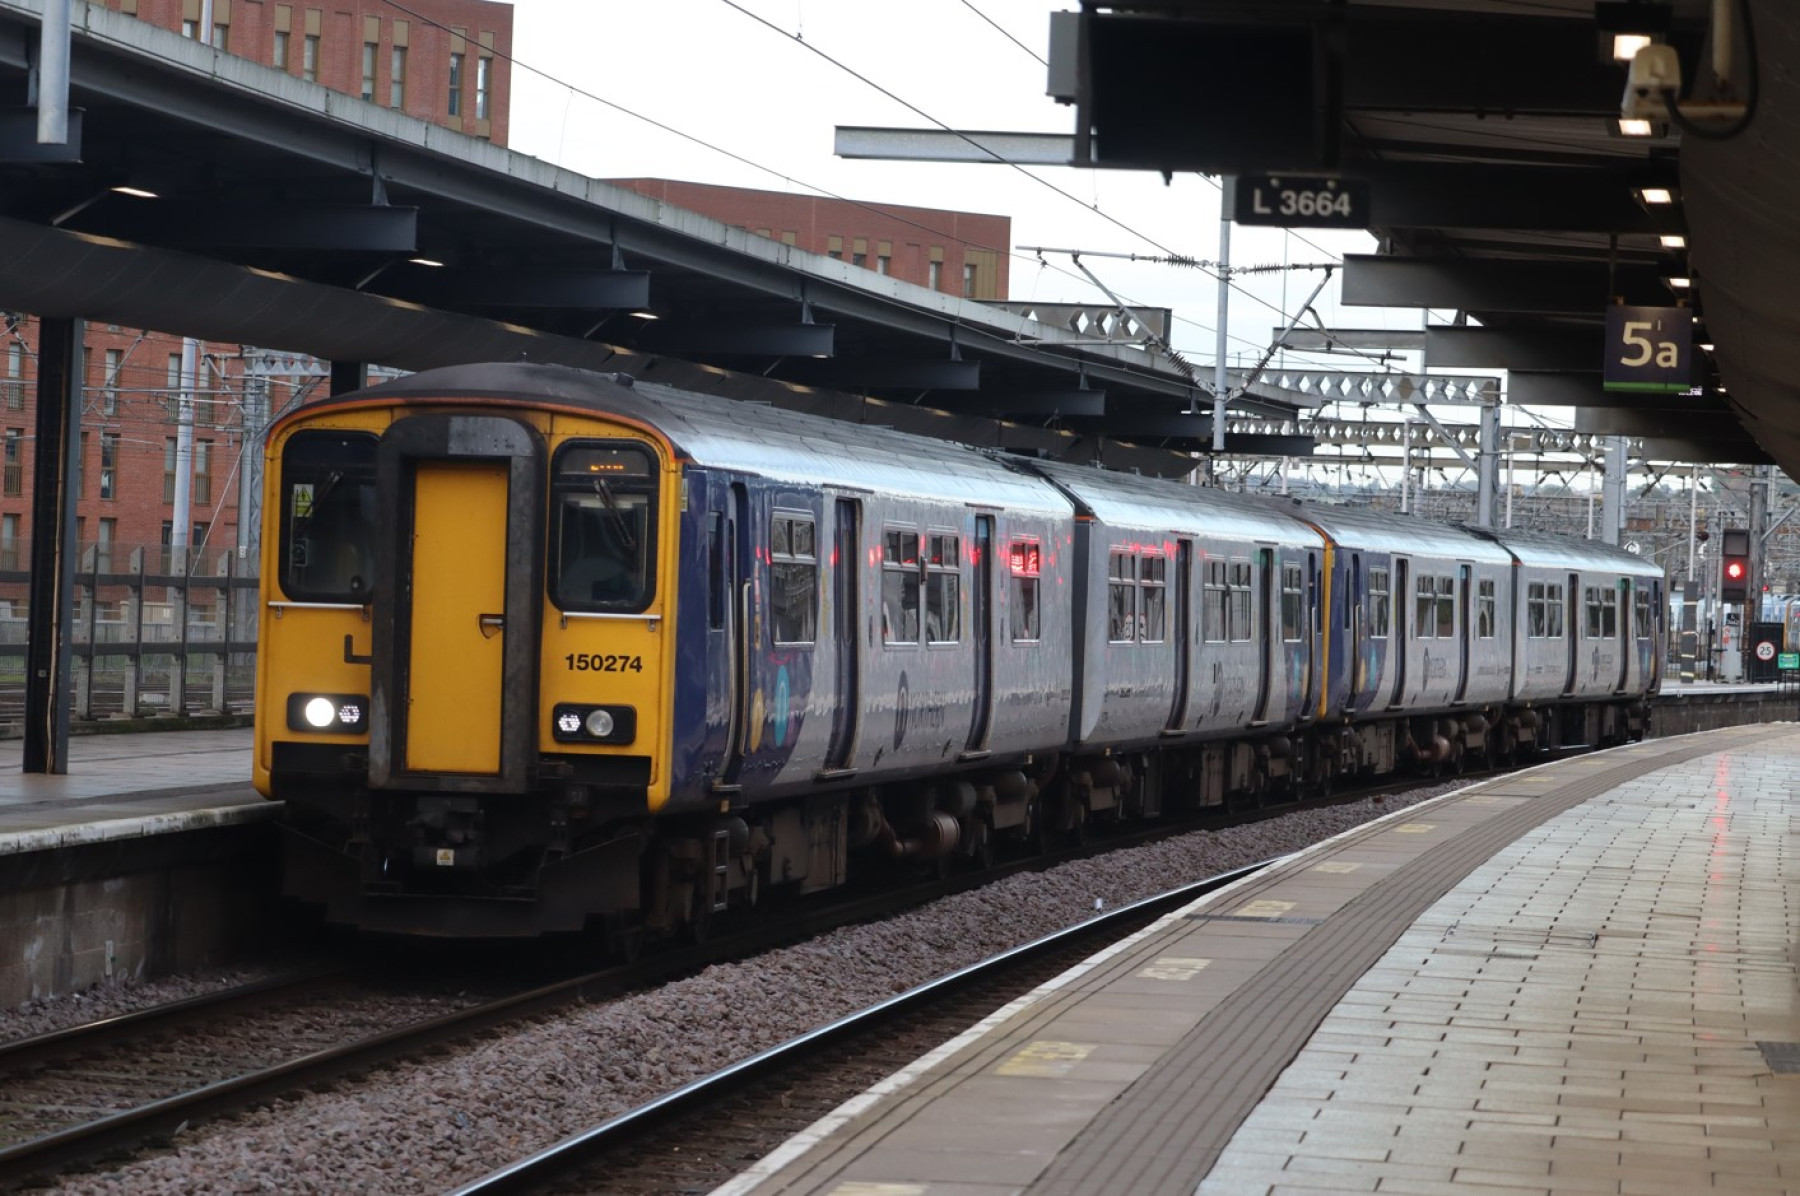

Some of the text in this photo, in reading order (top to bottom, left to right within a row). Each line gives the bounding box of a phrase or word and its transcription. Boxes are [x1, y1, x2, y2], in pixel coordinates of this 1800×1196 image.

[1253, 189, 1351, 217] L 3664
[1620, 321, 1678, 368] 5a
[565, 653, 643, 673] 150274
[1760, 646, 1772, 656] 25
